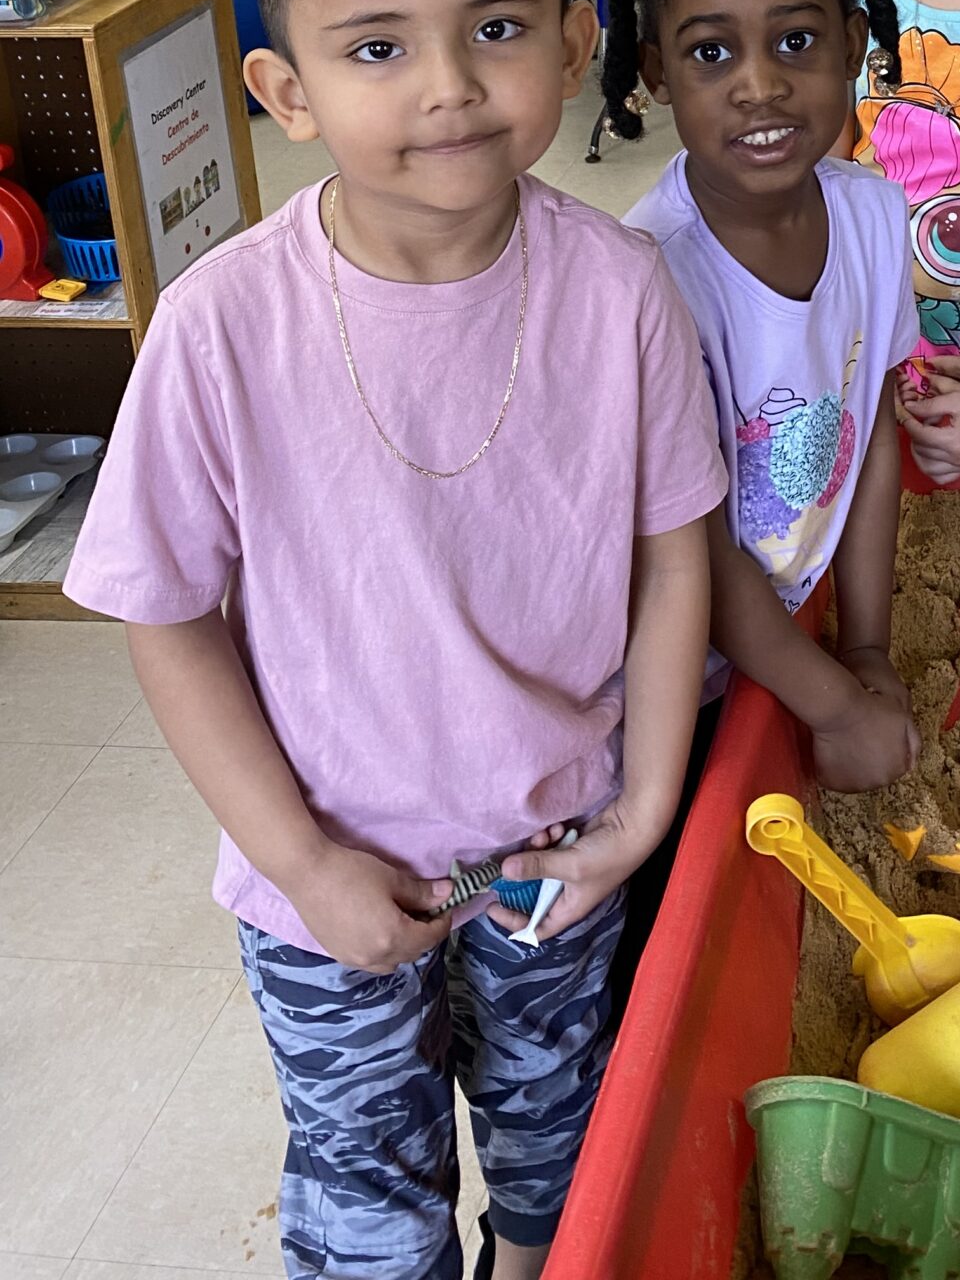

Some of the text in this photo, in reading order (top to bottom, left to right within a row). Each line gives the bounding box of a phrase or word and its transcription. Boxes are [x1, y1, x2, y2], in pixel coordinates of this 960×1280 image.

[151, 79, 207, 125] Discovery Center
[167, 108, 200, 139] Centro de
[161, 122, 210, 166] Descubrimiento
